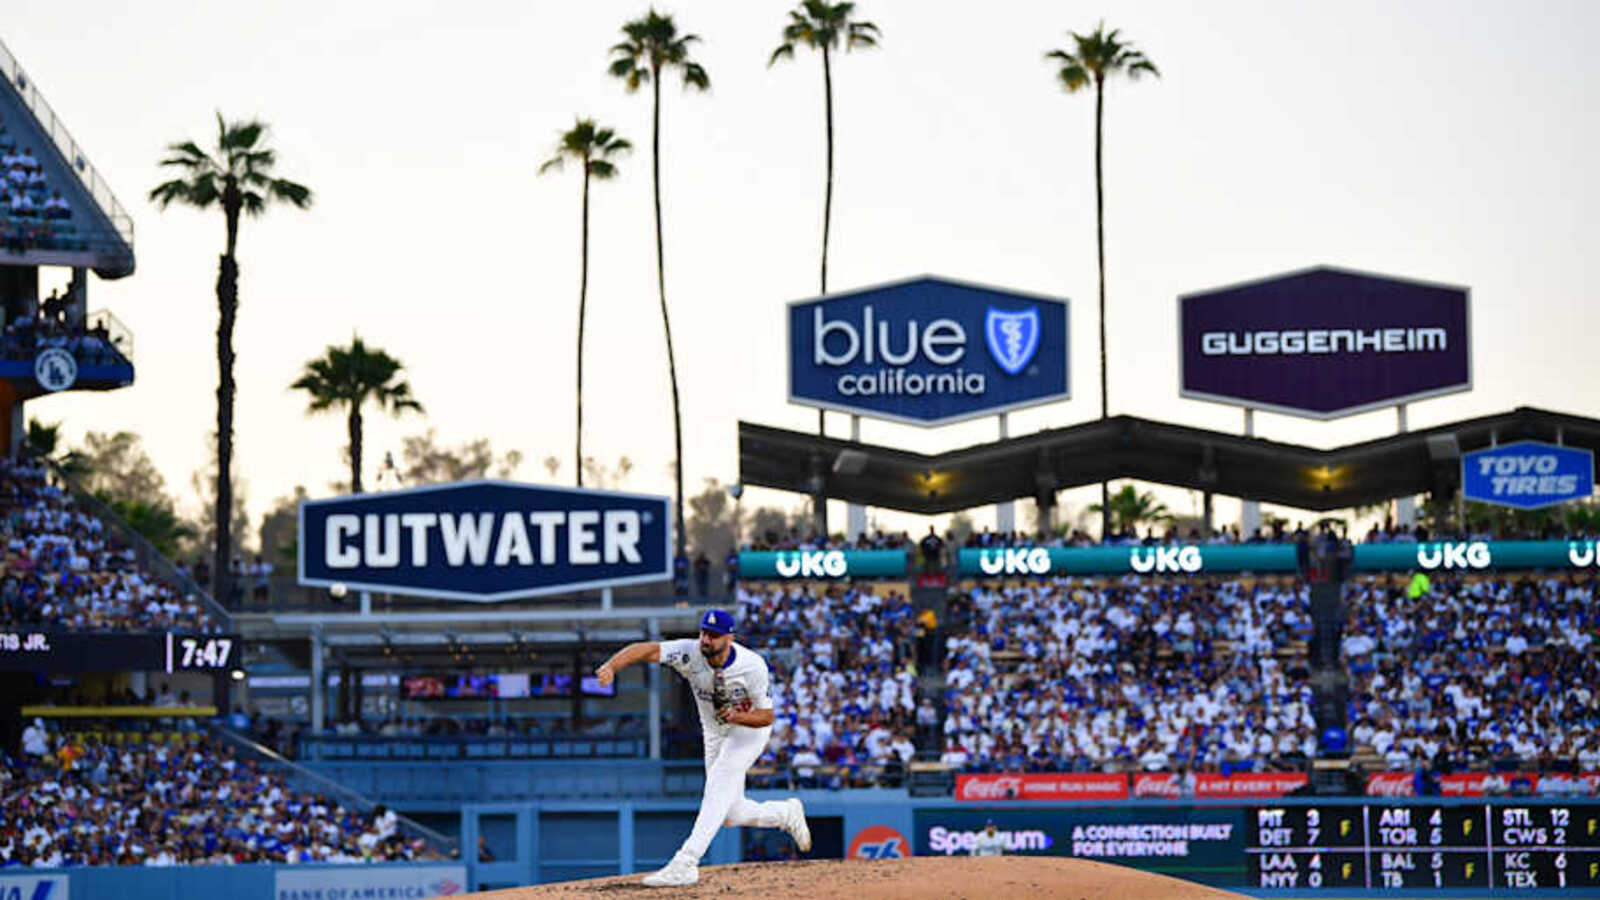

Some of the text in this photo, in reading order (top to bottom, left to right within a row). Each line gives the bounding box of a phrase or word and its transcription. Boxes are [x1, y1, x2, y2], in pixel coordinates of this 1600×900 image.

[813, 305, 967, 366] blue
[1202, 327, 1447, 355] GUGGENHEIM
[837, 368, 986, 396] california
[1478, 455, 1558, 475] TOYO
[1491, 474, 1577, 495] TIRES
[324, 510, 643, 568] CUTWATER
[980, 546, 1203, 575] UKG UKG
[1417, 541, 1600, 569] UKG U
[776, 551, 848, 577] UKG
[181, 639, 232, 667] 7:47
[1258, 809, 1320, 827] PIT 3
[1379, 809, 1442, 827] ARI 4
[1503, 808, 1569, 826] STL 12
[1072, 824, 1232, 840] A CONNECTION BUILT
[1463, 819, 1472, 836] F
[1588, 819, 1597, 835] F
[1259, 828, 1320, 846] DET 7
[1379, 828, 1442, 845] TOR 5
[1503, 828, 1566, 844] CWS 2
[1073, 841, 1188, 856] FOR EVERYONE
[1261, 854, 1322, 871] LAA 4
[1381, 853, 1443, 870] BAL 5
[1505, 853, 1567, 869] KC 6
[1342, 863, 1352, 880] F
[1382, 871, 1442, 887] TB 1
[1465, 862, 1474, 879] F
[1504, 871, 1566, 887] TEX 1
[1589, 863, 1598, 879] F
[1261, 871, 1322, 888] NYY 0
[352, 885, 425, 898] AMERICA
